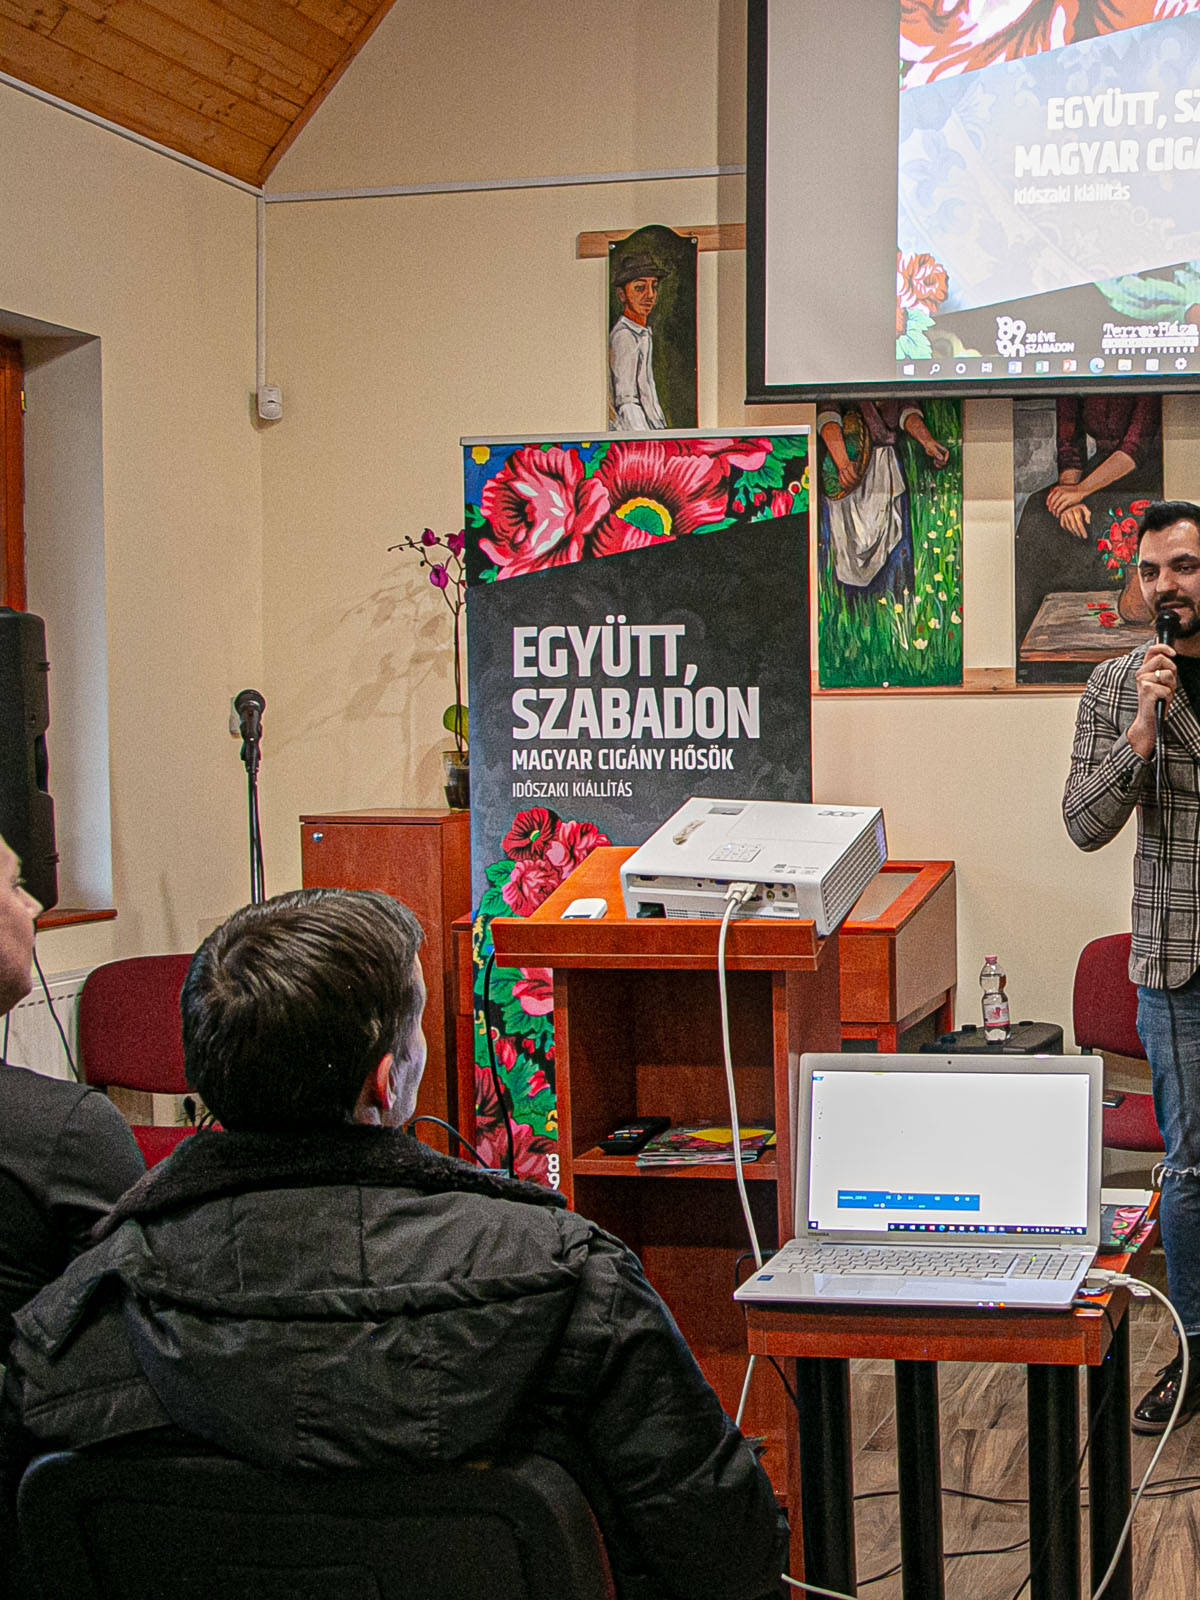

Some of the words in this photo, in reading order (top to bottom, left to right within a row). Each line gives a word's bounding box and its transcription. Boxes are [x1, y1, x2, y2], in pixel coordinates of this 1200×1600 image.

[1047, 88, 1168, 131] EGYÜTT,
[1014, 140, 1139, 178] MAGYAR
[1026, 342, 1075, 354] SZABADON
[513, 614, 698, 686] EGYÜTT,
[512, 686, 760, 740] SZABADON
[512, 749, 593, 771] MAGYAR
[598, 744, 666, 771] CIGÁNY
[670, 744, 734, 770] HŐSÖK
[512, 779, 569, 798] IDŐSZAKI
[572, 779, 633, 798] KIÁLLÍTÁS
